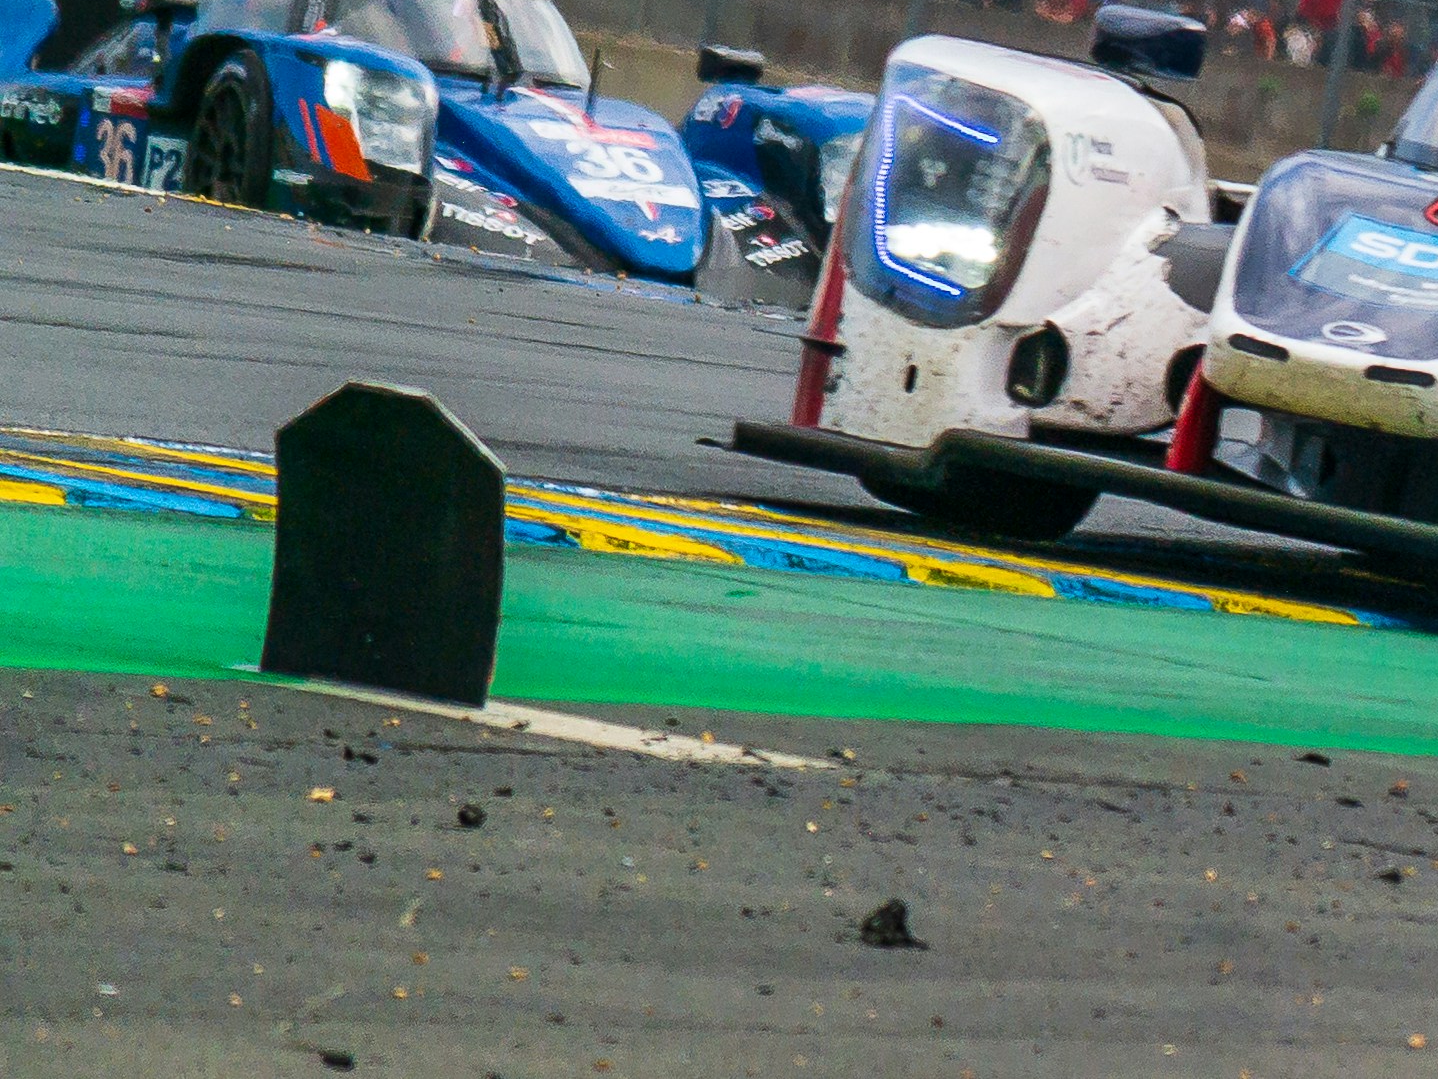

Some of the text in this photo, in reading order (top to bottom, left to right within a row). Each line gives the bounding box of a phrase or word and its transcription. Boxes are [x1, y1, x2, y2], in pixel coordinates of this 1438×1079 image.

[97, 119, 184, 192] 36 P2
[566, 139, 663, 183] 36
[441, 200, 551, 245] TISSOT
